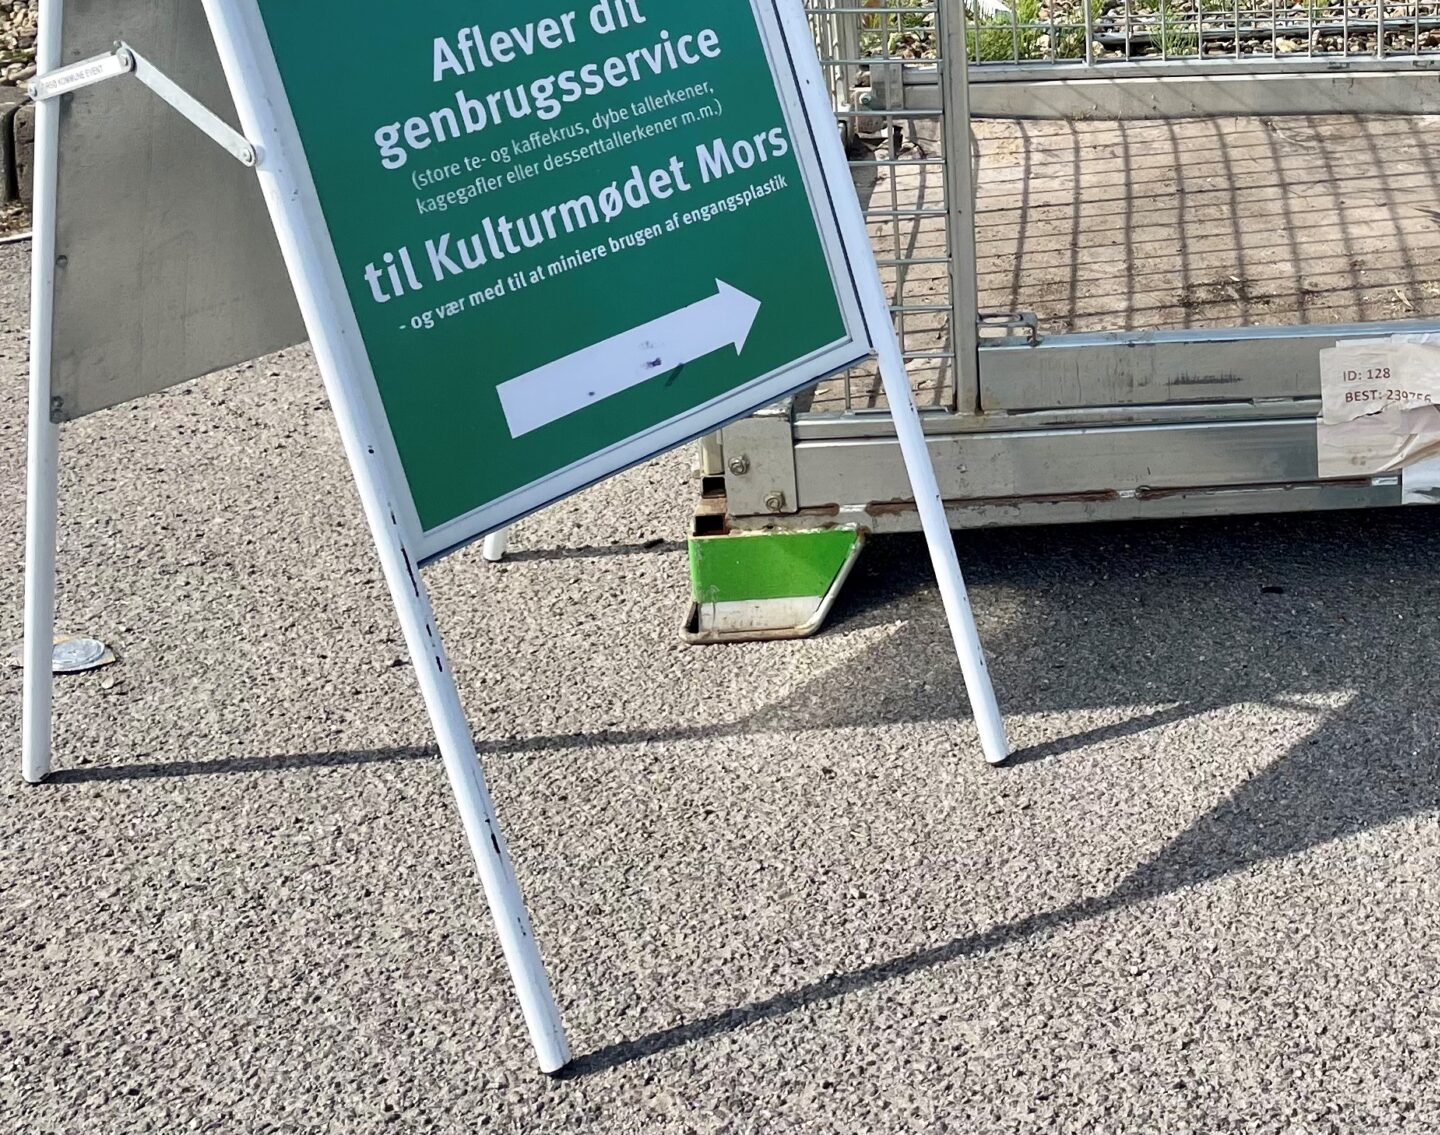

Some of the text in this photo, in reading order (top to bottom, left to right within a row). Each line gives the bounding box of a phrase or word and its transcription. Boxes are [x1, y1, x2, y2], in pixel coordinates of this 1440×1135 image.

[374, 28, 722, 170] genbrugsservice
[433, 10, 577, 82] Aflever
[411, 80, 715, 191] (store te- og kaffekrus, dybe tallerkener,
[416, 98, 723, 214] kagegafler eller desserttallerkener m.m.)
[364, 127, 789, 303] til Kulturmødet Mors
[410, 310, 435, 329] og
[435, 297, 465, 319] vær
[468, 279, 506, 307] med
[507, 271, 528, 292] til
[529, 265, 546, 284] at
[547, 244, 608, 276] miniere
[608, 223, 663, 253] brugen
[664, 212, 681, 232] af
[682, 173, 789, 225] engangsplastik
[1343, 367, 1391, 382] ID: 128
[1345, 389, 1382, 403] BEST:
